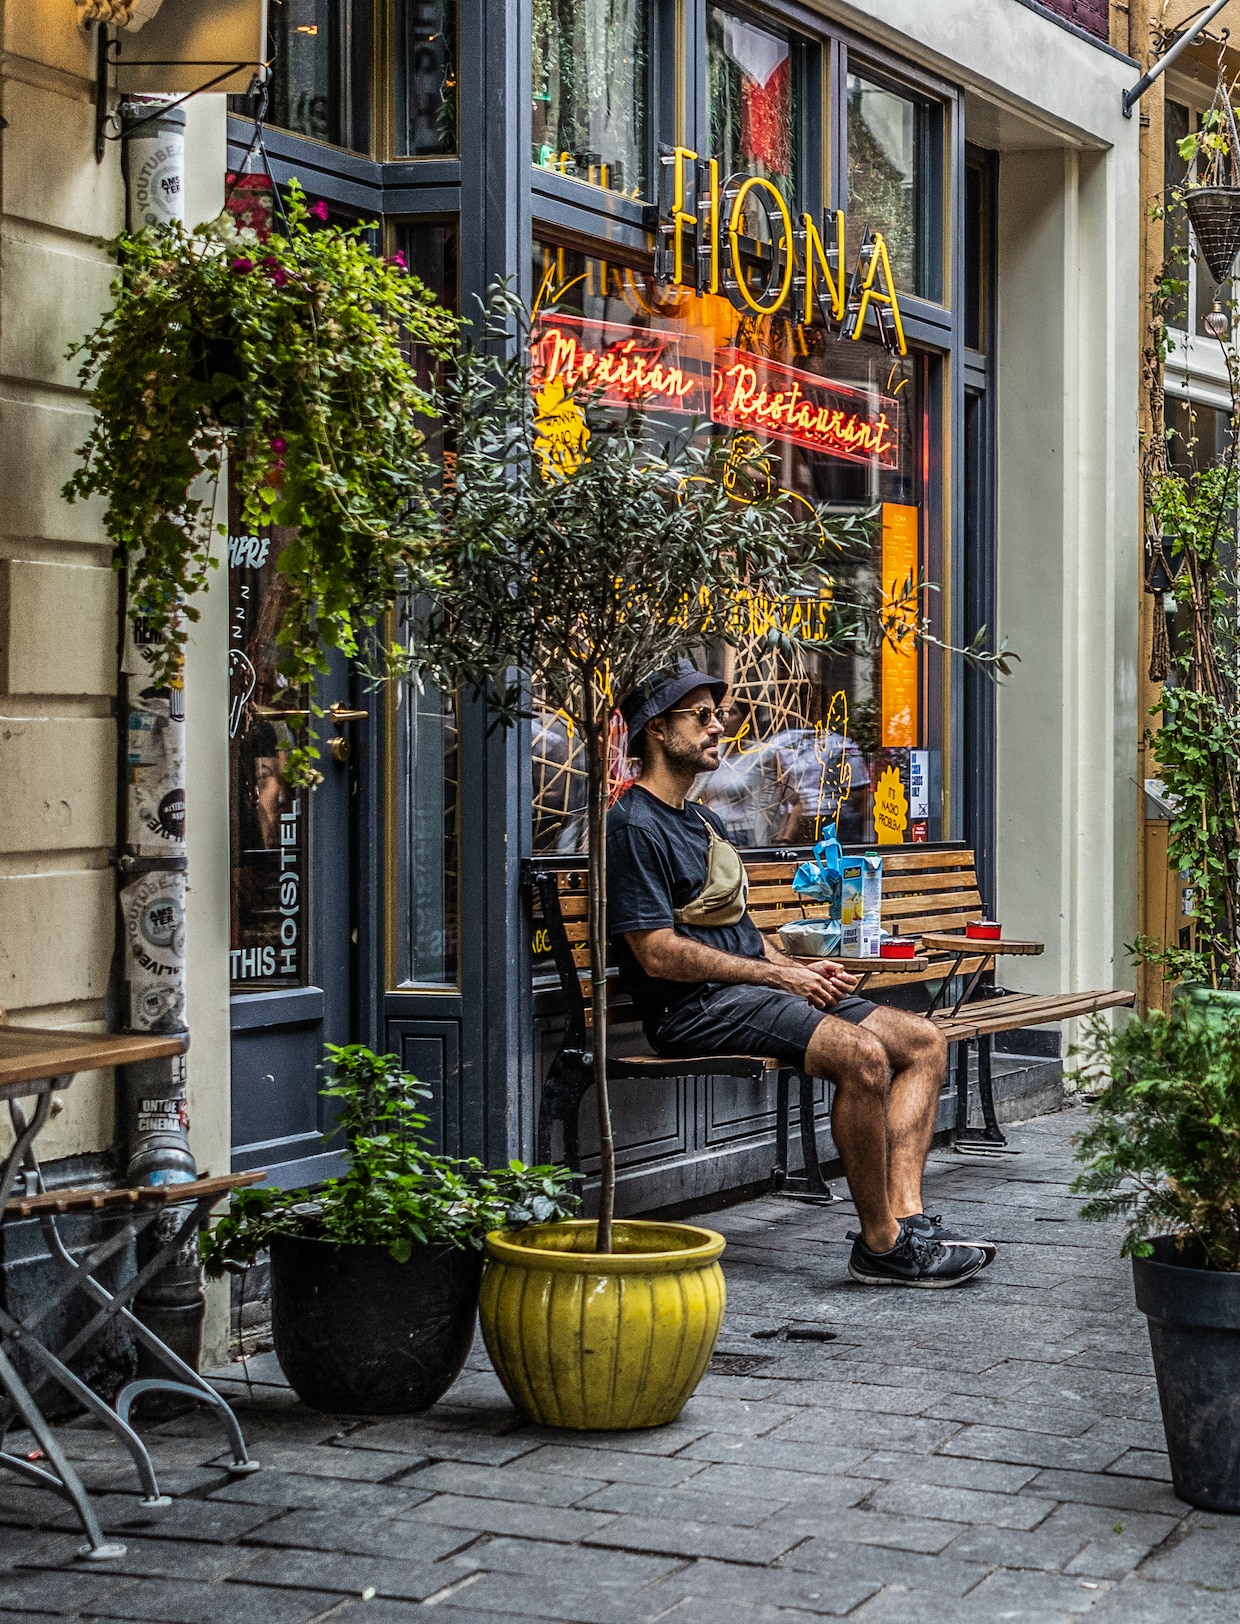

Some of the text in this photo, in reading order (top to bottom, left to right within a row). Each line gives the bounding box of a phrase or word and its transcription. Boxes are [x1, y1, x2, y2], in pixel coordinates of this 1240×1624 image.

[671, 146, 907, 356] FIONA
[545, 328, 892, 454] Mexican Restaurant
[878, 812, 901, 832] PROBLEM
[280, 800, 299, 974] HO(S)TEL
[150, 906, 174, 921] AMS
[230, 945, 276, 980] THIS
[139, 1118, 180, 1132] CINEMA
